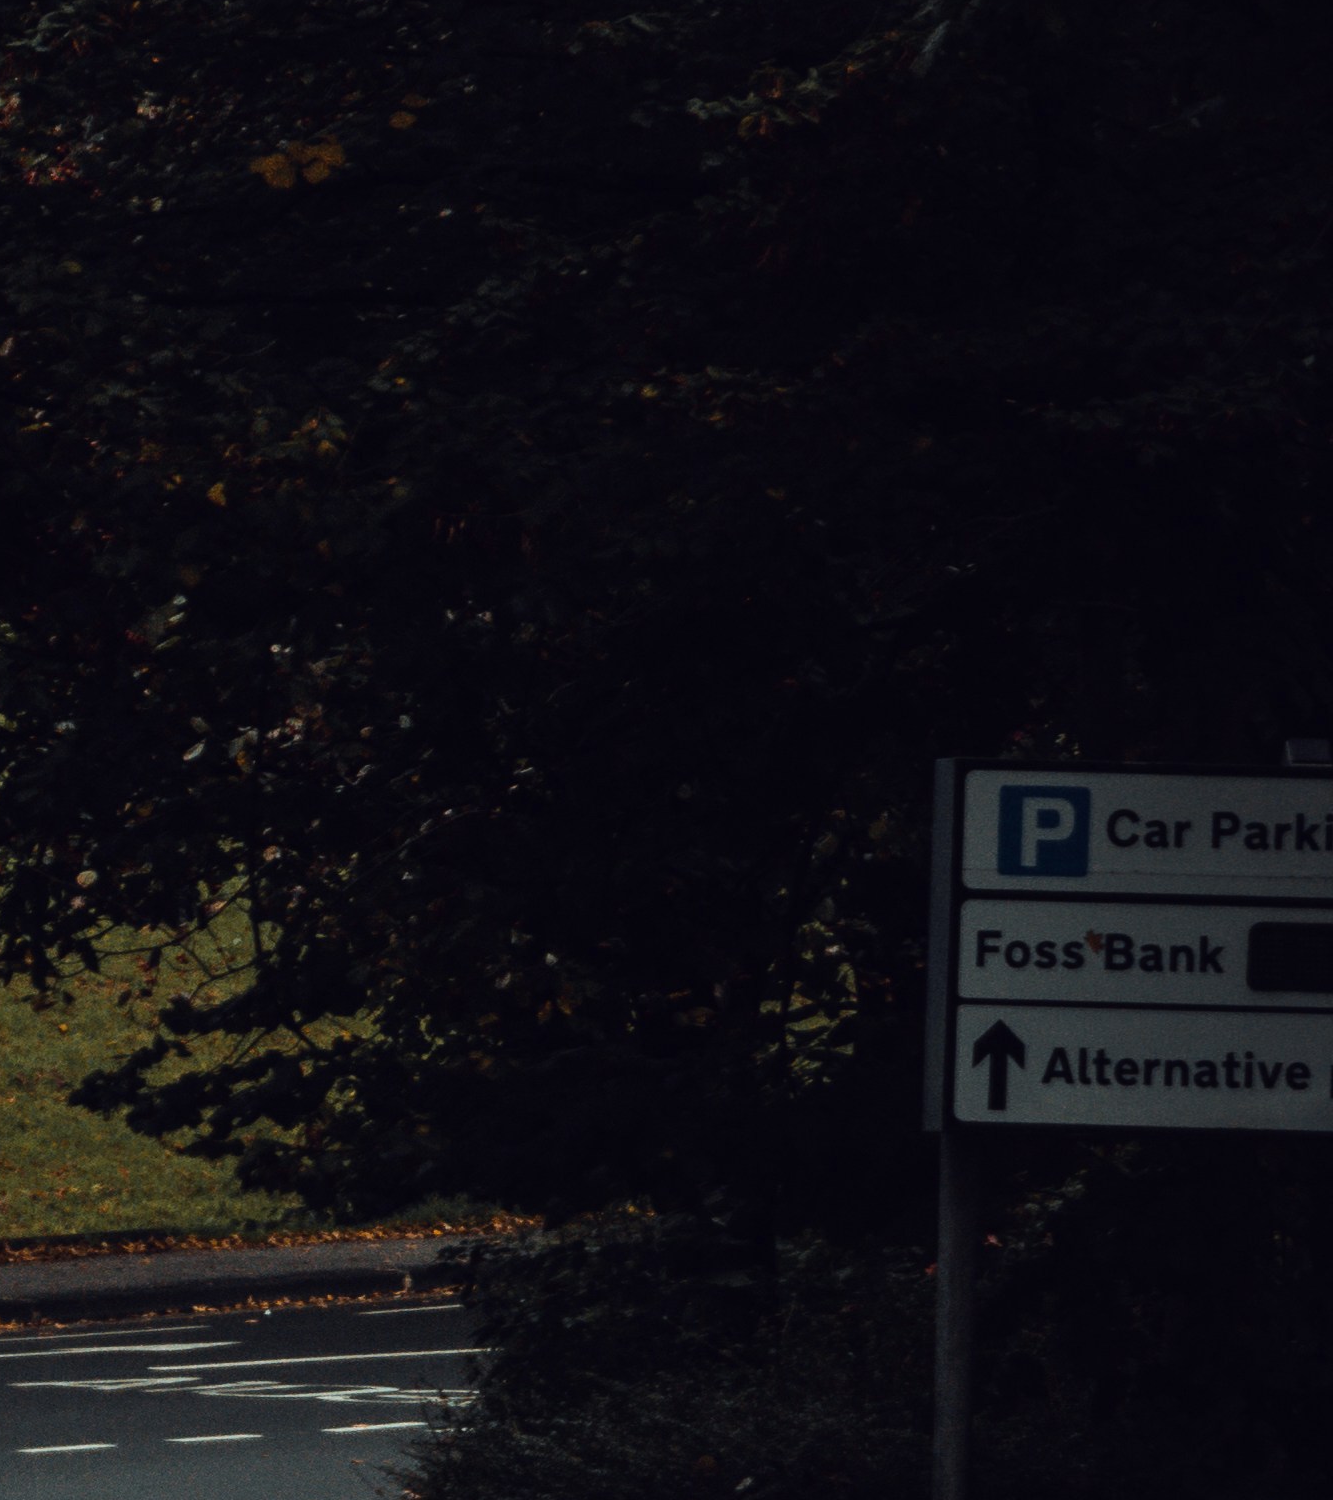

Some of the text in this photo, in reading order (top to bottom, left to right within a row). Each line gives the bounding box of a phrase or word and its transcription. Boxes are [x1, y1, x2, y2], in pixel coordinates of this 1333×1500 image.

[1020, 797, 1076, 867] P
[1106, 809, 1192, 849] Car
[975, 929, 1226, 974] Foss Bank
[1041, 1046, 1312, 1091] Alternative
